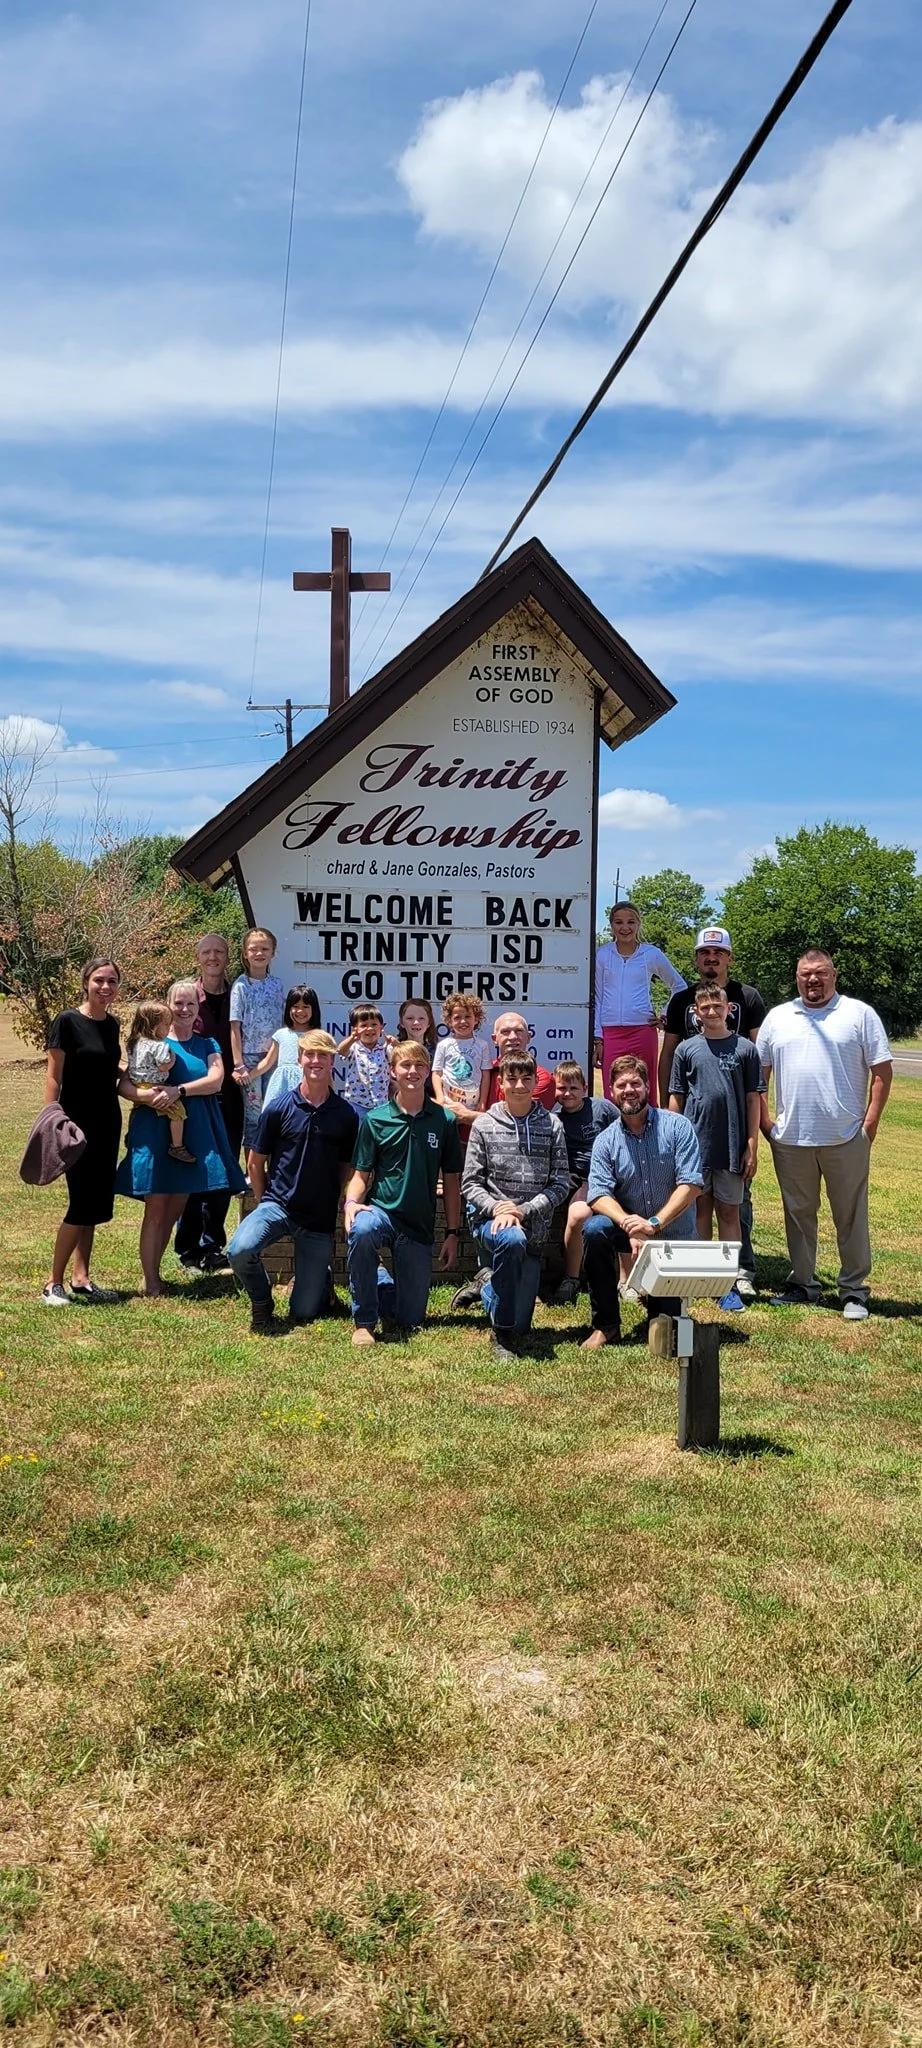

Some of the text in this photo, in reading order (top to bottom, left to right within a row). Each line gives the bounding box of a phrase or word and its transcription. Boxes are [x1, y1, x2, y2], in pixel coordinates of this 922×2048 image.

[492, 644, 537, 660] FIRST
[468, 665, 561, 682] ASSEMBLY
[475, 687, 553, 704] OF GOD
[453, 718, 575, 735] ESTABLISHED 1934
[359, 743, 569, 802] Trinity
[282, 801, 583, 859] Fellowship
[326, 859, 536, 881] chard & Jane Gonzales, Pastors
[296, 891, 573, 929] WELCOME BACK
[318, 931, 544, 965] TRINITY ISD
[341, 968, 530, 1003] GO TIGERS!
[546, 1027, 574, 1039] am
[547, 1049, 574, 1061] am
